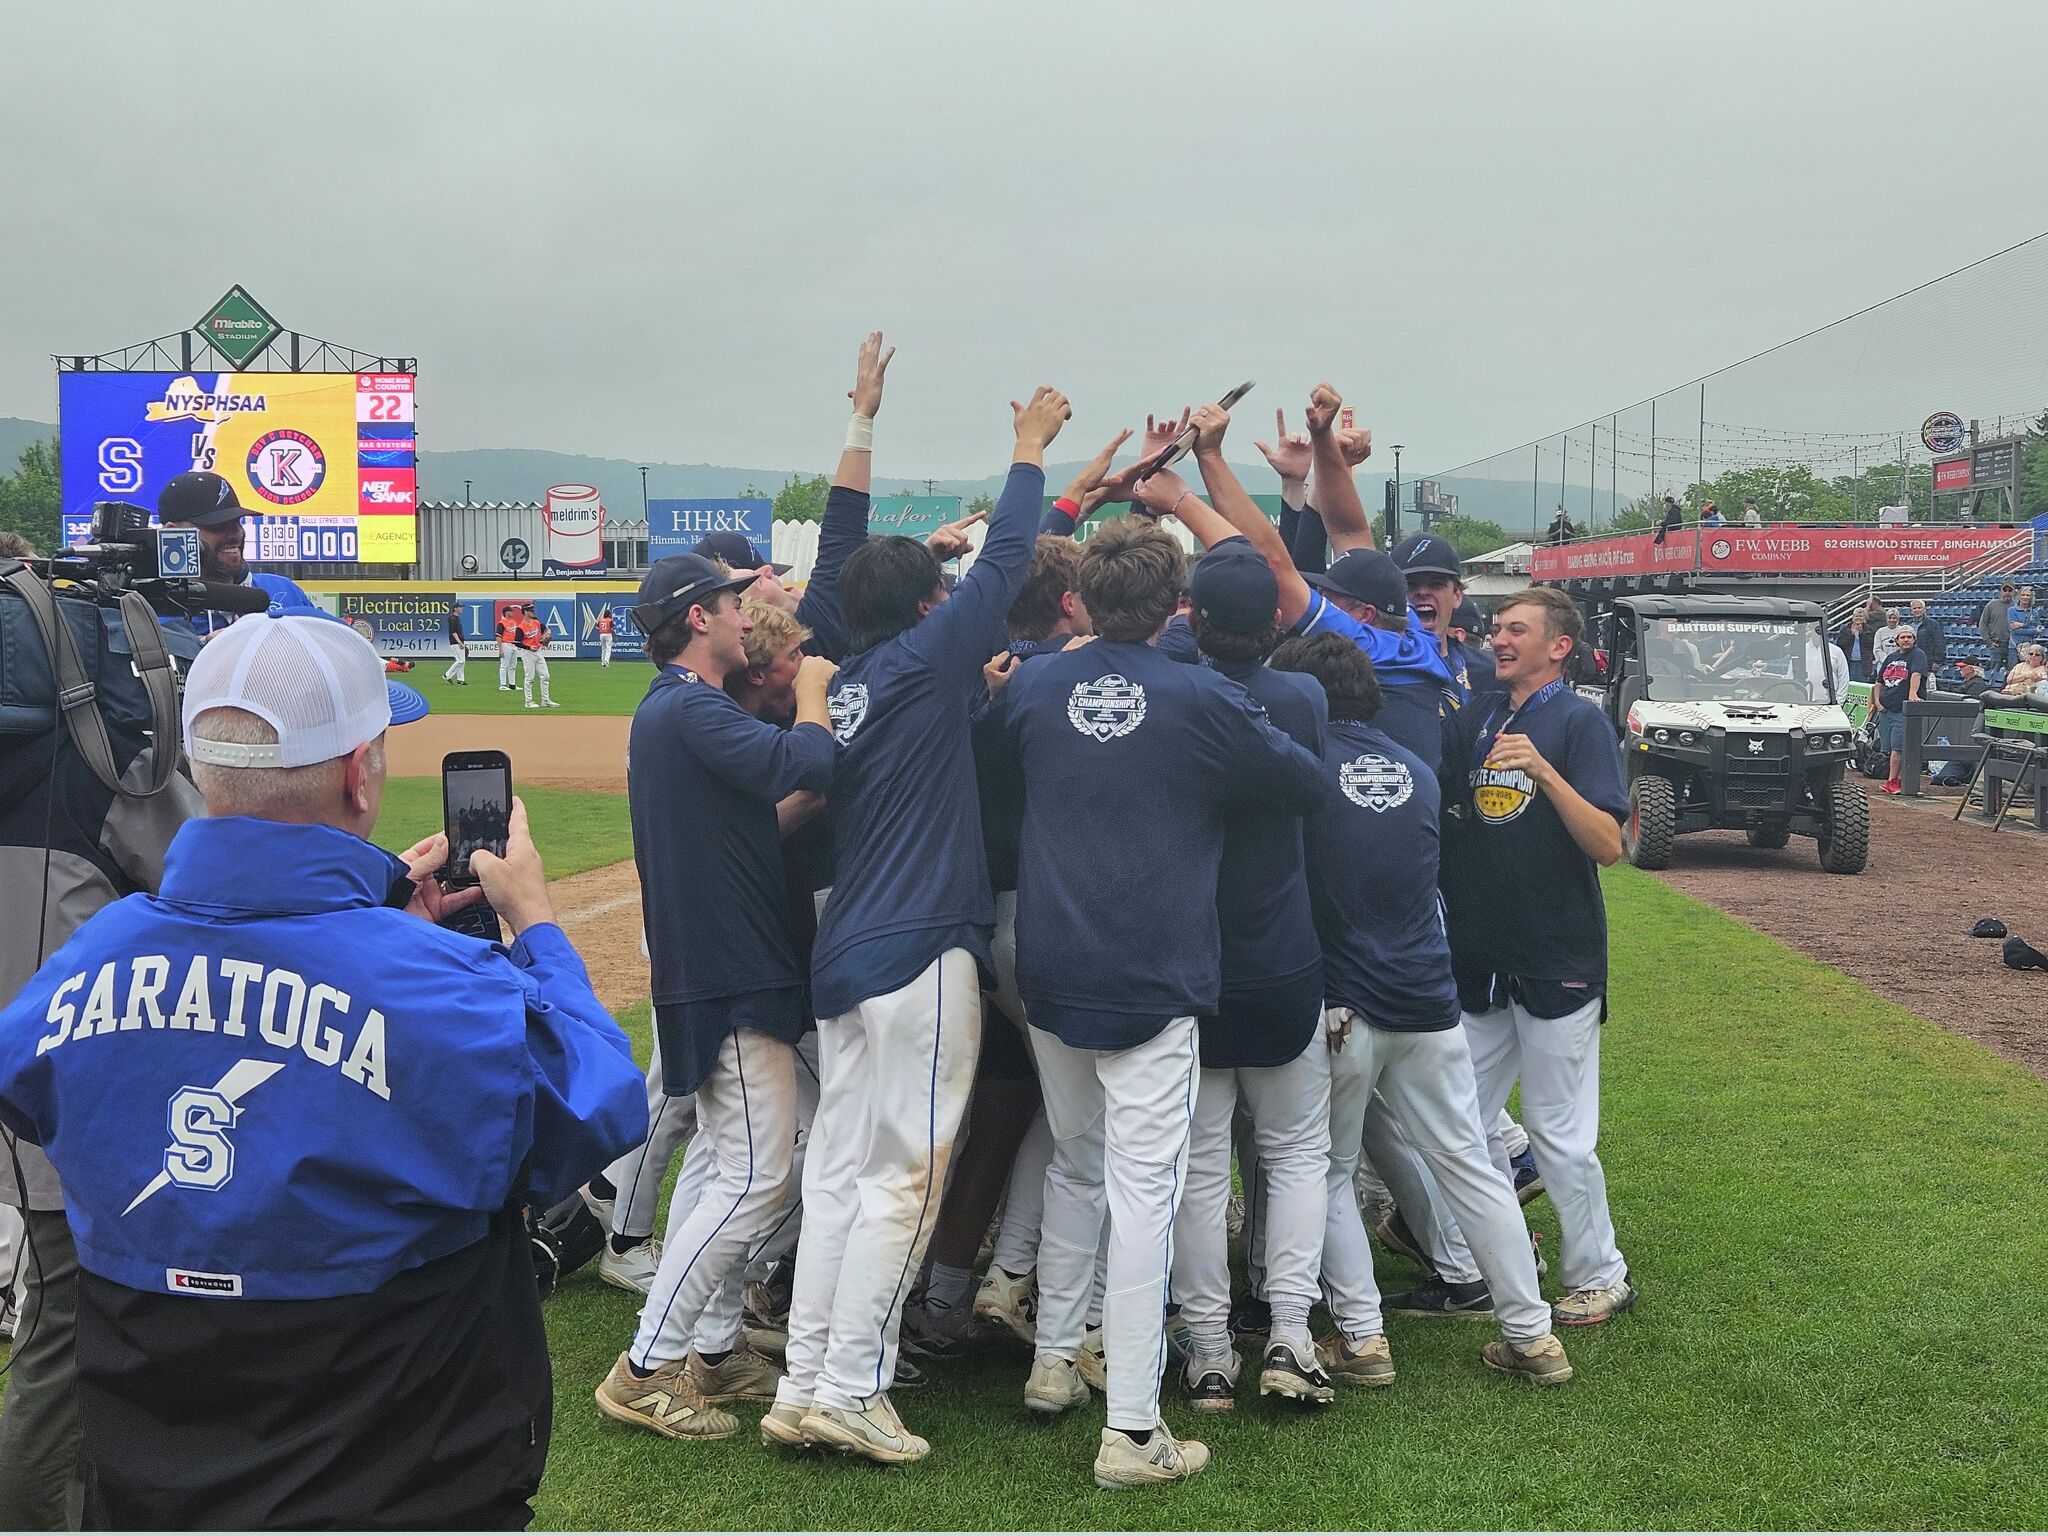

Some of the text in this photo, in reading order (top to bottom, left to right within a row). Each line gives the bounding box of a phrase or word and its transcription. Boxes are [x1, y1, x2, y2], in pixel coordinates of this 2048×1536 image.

[214, 319, 263, 329] Mirabito
[165, 394, 267, 412] NYSPHSAA
[369, 395, 402, 420] 22
[98, 437, 144, 493] S
[269, 448, 303, 487] K
[362, 481, 395, 493] NBT
[551, 507, 598, 521] meldrim's
[671, 509, 752, 532] HH&K
[868, 504, 948, 528] hafer's
[263, 526, 270, 539] 8
[273, 526, 284, 539] 13
[375, 532, 415, 541] AGENCY
[302, 531, 355, 556] 0 0 0
[650, 535, 689, 546] Hinman,
[1735, 539, 1810, 551] F.W. WEBB
[1824, 540, 1838, 549] 62
[1839, 540, 1898, 549] GRISWOLD
[1900, 540, 1939, 549] STREET
[186, 532, 198, 574] NEWS
[273, 544, 284, 557] 10
[502, 544, 527, 564] 42
[556, 569, 584, 577] Benjamin
[346, 595, 450, 614] Electricians
[379, 618, 441, 632] Local 325
[1667, 623, 1798, 635] BARTRON SUPPLY INC.
[381, 638, 437, 651] 729-6171
[464, 643, 499, 652] SURANCE
[1077, 697, 1137, 709] CHAMPIONSHIPS
[1348, 774, 1405, 784] CHAMPIONSHIPS
[36, 955, 392, 1101] SARATOGA
[163, 1085, 238, 1192] S
